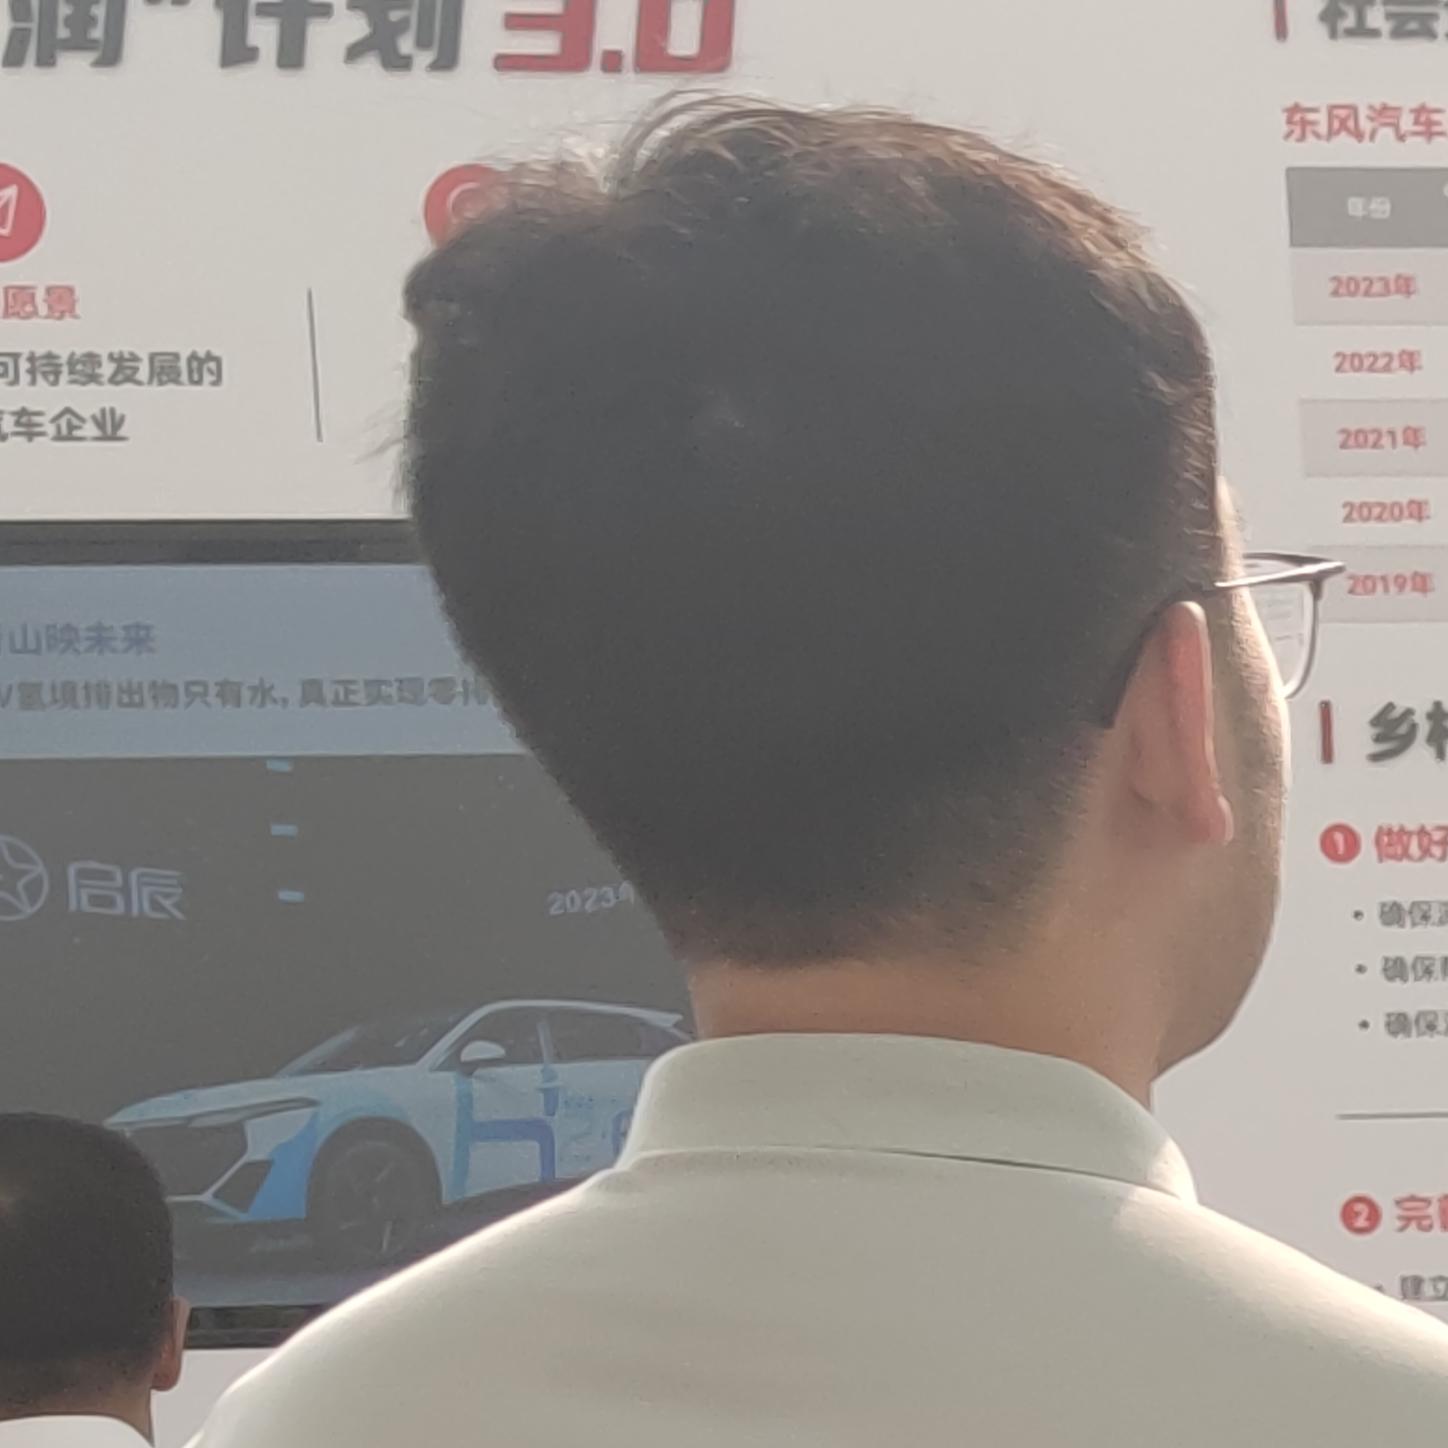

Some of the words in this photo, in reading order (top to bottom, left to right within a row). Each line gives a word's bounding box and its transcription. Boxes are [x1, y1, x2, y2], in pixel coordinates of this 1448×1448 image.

[1328, 273, 1418, 299] 2023年
[0, 350, 223, 386] 可持续发展的
[1333, 349, 1423, 374] 2022年
[0, 406, 130, 442] 车企业
[1337, 425, 1426, 450] 2021年
[1342, 498, 1431, 523] 2020年
[1346, 571, 1435, 597] 2019年
[66, 861, 187, 920] 启辰
